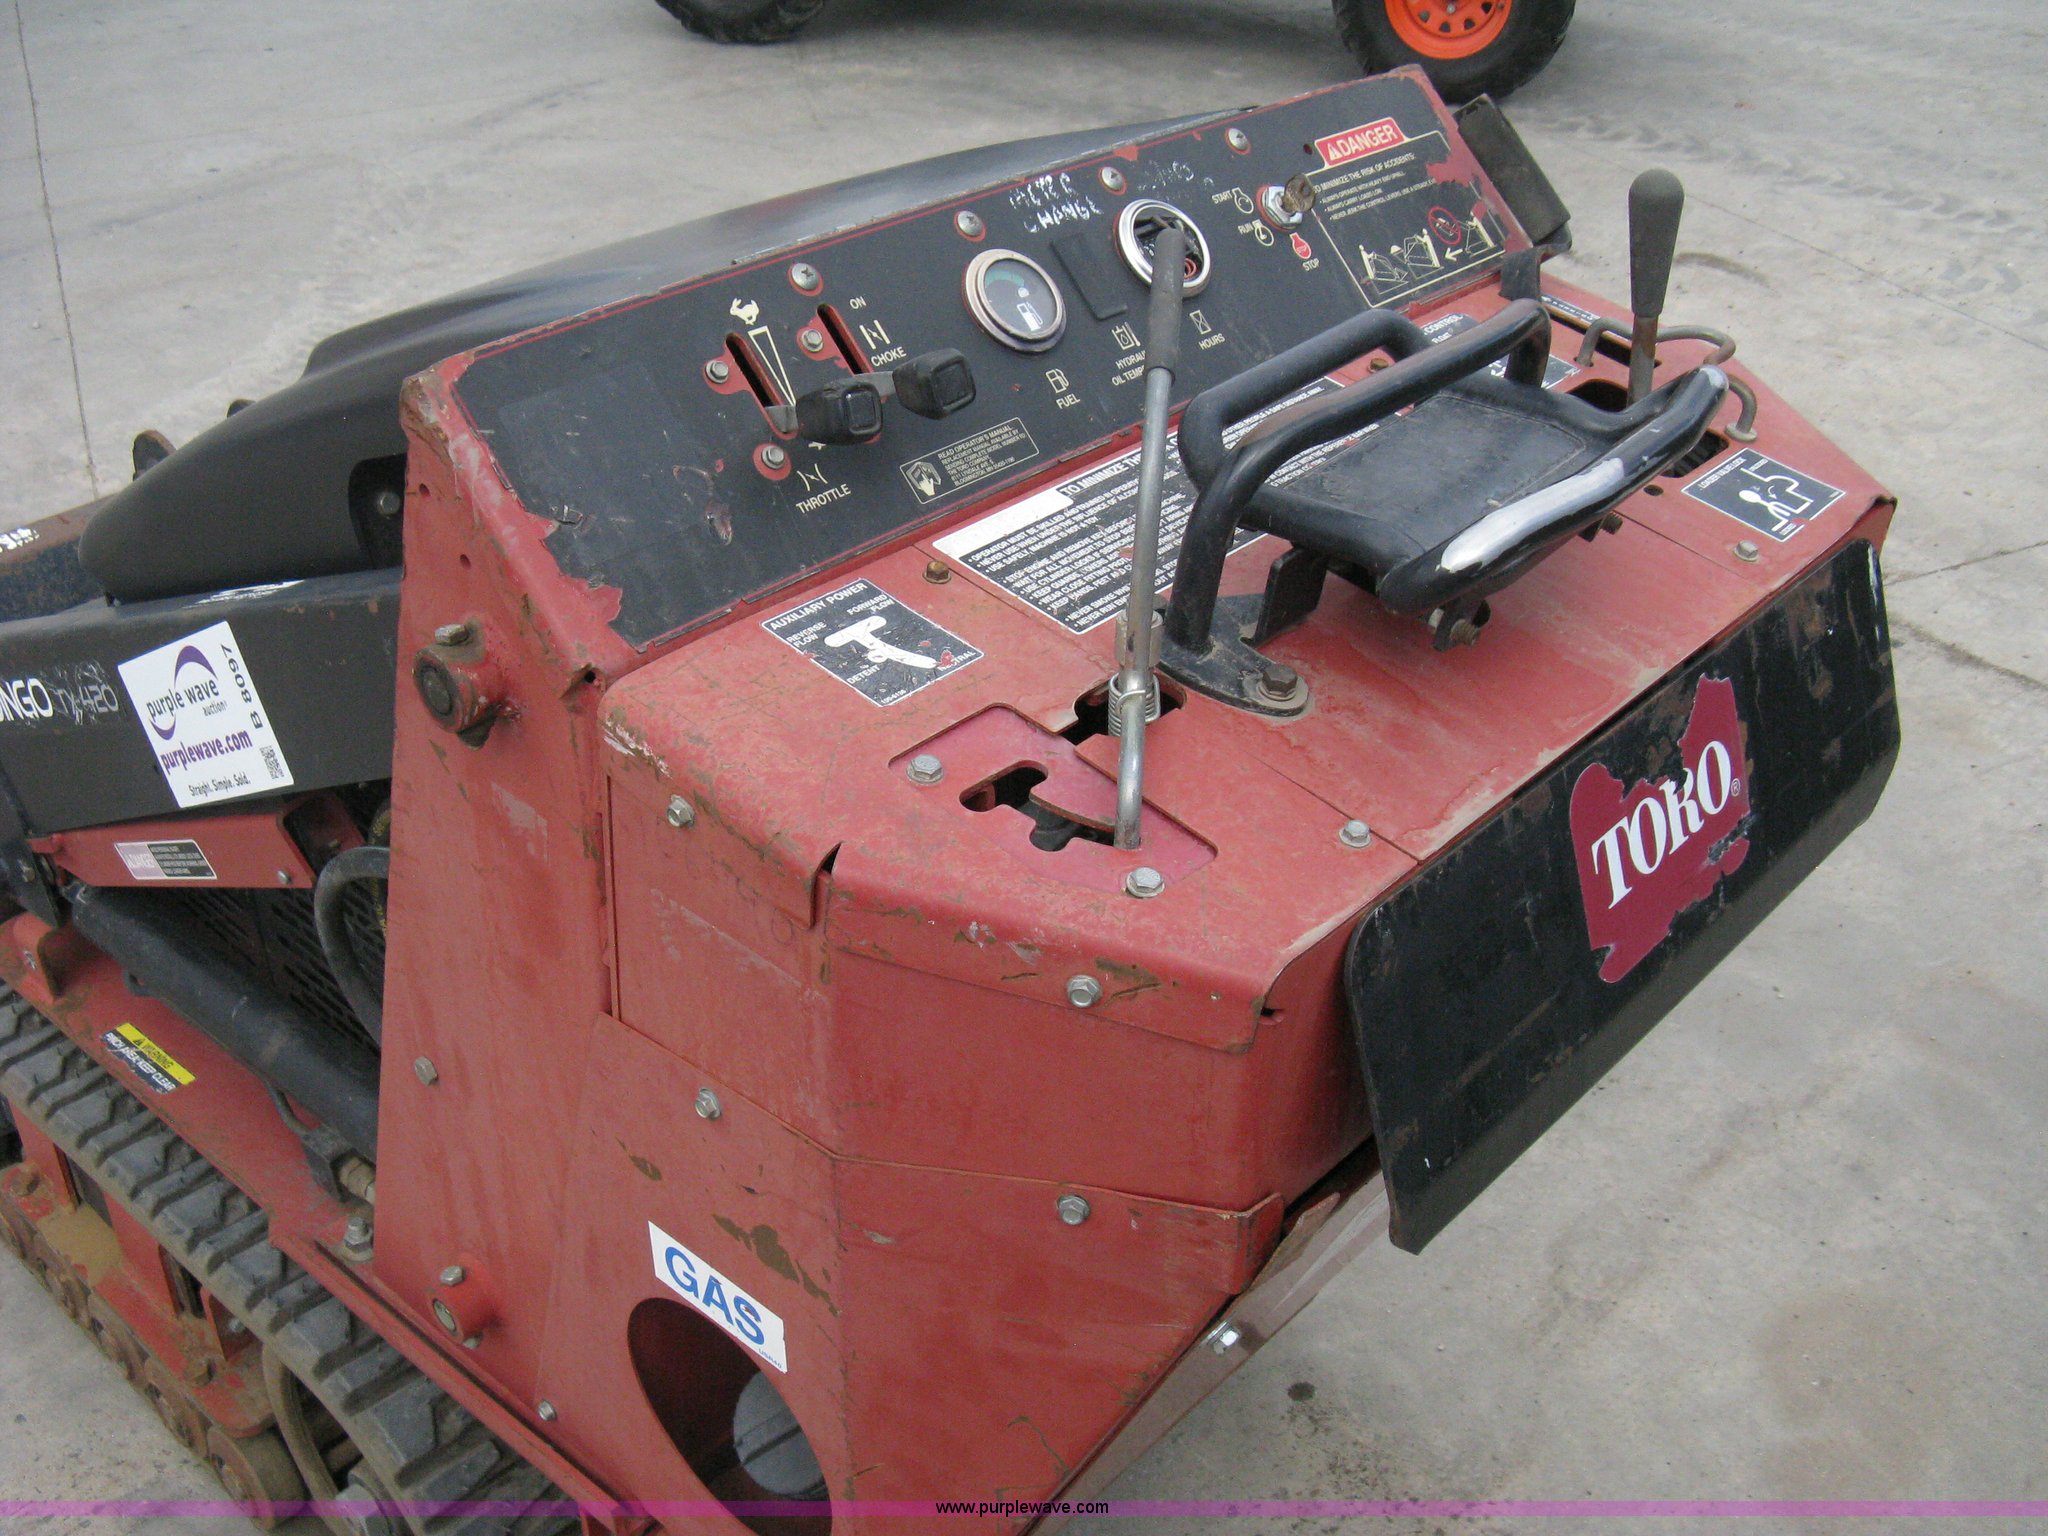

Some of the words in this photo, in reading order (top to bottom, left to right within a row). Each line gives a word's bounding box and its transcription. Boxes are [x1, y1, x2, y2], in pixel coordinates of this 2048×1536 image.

[1337, 124, 1398, 157] DANGER
[1348, 171, 1361, 180] THE
[1361, 167, 1375, 176] RISK
[1375, 163, 1383, 171] OF
[1212, 190, 1233, 205] START
[1238, 223, 1254, 235] RUN
[1303, 258, 1320, 272] STOP
[850, 296, 866, 310] ON
[1199, 333, 1225, 350] HOURS
[871, 347, 907, 367] CHOKE
[1116, 351, 1146, 370] HYDRAU
[1112, 372, 1125, 386] OIL
[1056, 393, 1080, 409] FUEL
[938, 449, 954, 459] READ
[1060, 485, 1081, 497] TO
[1077, 463, 1129, 489] MINIMIZE
[796, 484, 851, 514] THROTTLE
[971, 541, 1010, 561] OPERATOR
[1007, 532, 1028, 544] MUST
[1026, 527, 1039, 535] BE
[1076, 496, 1105, 510] TRAINED
[980, 553, 1005, 566] NEVER
[1003, 545, 1020, 555] USE
[1016, 536, 1040, 548] WHEN
[1058, 519, 1075, 528] THE
[1072, 502, 1109, 522] INFLUENCE
[988, 562, 1005, 571] USE
[1029, 535, 1061, 552] MACHINE
[1065, 525, 1081, 534] NOT
[1006, 570, 1025, 582] STOP
[1024, 558, 1052, 573] ENGINE
[1050, 551, 1066, 561] AND
[1064, 537, 1094, 553] REMOVE
[1030, 570, 1048, 579] FOR
[1046, 563, 1062, 572] ALL
[1103, 532, 1121, 543] STOP
[1023, 583, 1041, 593] USE
[1038, 567, 1073, 585] CYLINDER
[1070, 555, 1095, 569] LOCKS
[1040, 591, 1064, 604] WEAR
[1061, 579, 1086, 593] CLOSE
[1083, 567, 1111, 581] FITTING
[1032, 586, 1051, 598] KEEP
[1050, 597, 1069, 609] KEEP
[1093, 575, 1111, 587] FEET
[770, 601, 827, 631] AUXILIARY
[827, 582, 868, 605] POWER
[847, 593, 888, 615] FORWARD
[871, 599, 895, 614] FLOW
[1067, 605, 1093, 620] NEVER
[1090, 593, 1117, 608] SMOKE
[1077, 611, 1103, 626] NEVER
[1099, 603, 1117, 614] RUN
[786, 621, 827, 644] REVERSE
[794, 634, 819, 649] FLOW
[846, 665, 880, 685] DETENT
[146, 689, 185, 722] purple
[184, 679, 220, 705] wave
[160, 730, 253, 775] purplewave.com
[1591, 740, 1731, 909] TORO
[152, 1073, 175, 1091] CLEAR
[665, 1246, 764, 1345] GAS
